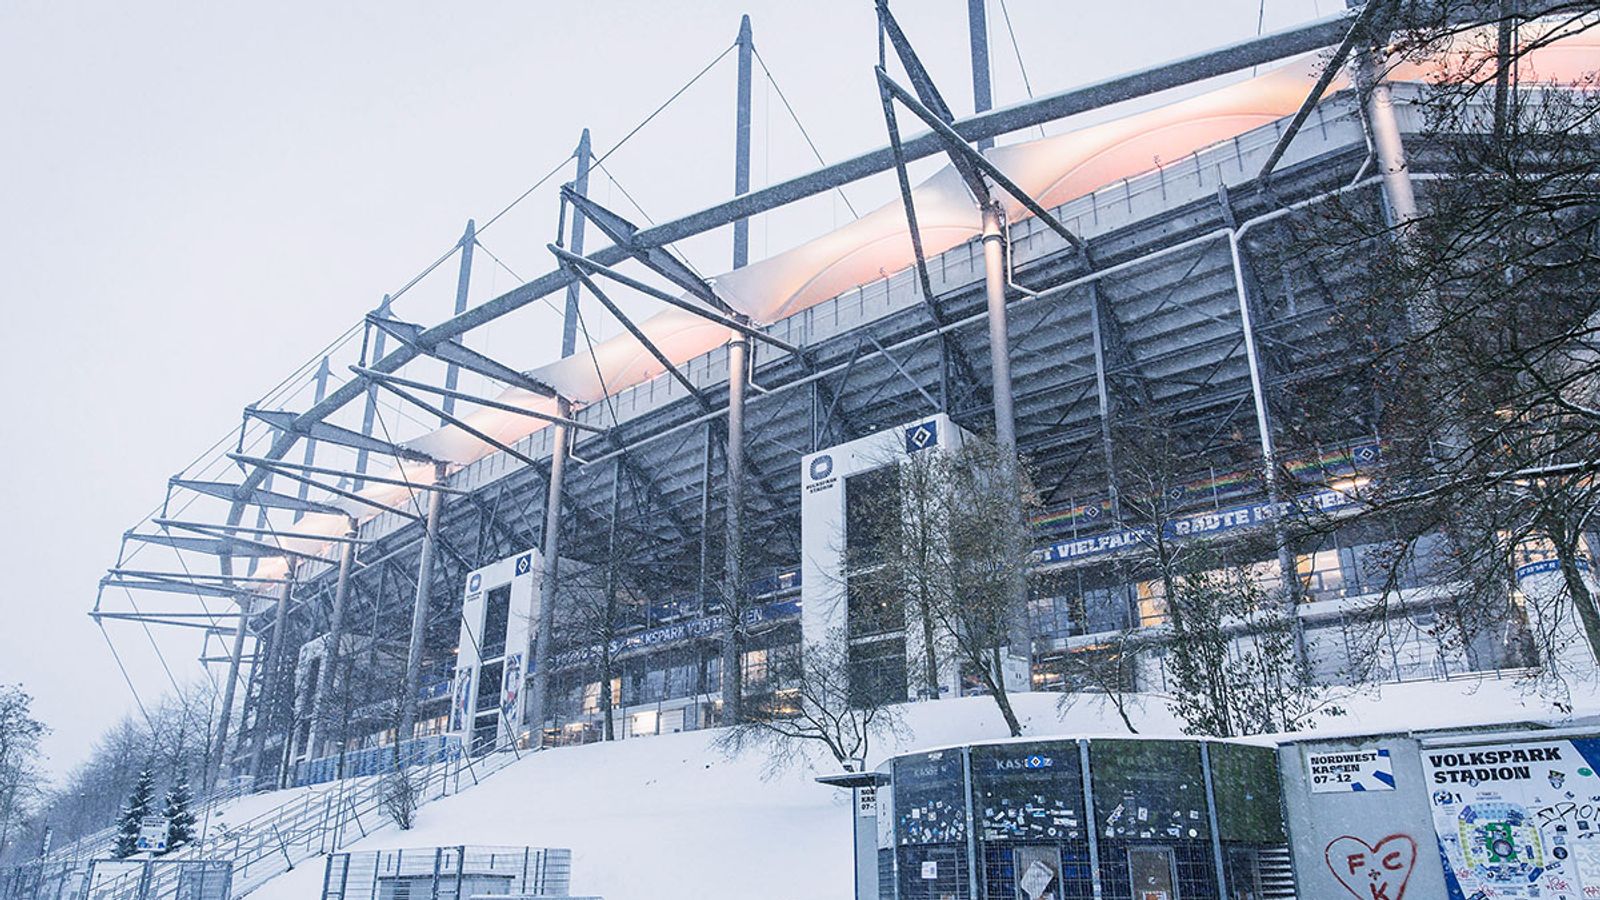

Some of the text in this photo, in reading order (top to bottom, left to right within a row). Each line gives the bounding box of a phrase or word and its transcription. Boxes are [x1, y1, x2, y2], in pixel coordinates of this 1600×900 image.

[1174, 509, 1249, 535] RAUTE
[1310, 753, 1377, 765] NORDWEST
[1429, 747, 1562, 768] VOLKSPARK
[1312, 764, 1360, 775] KASSEN
[1433, 766, 1531, 784] STADION
[1314, 774, 1352, 784] 07-12
